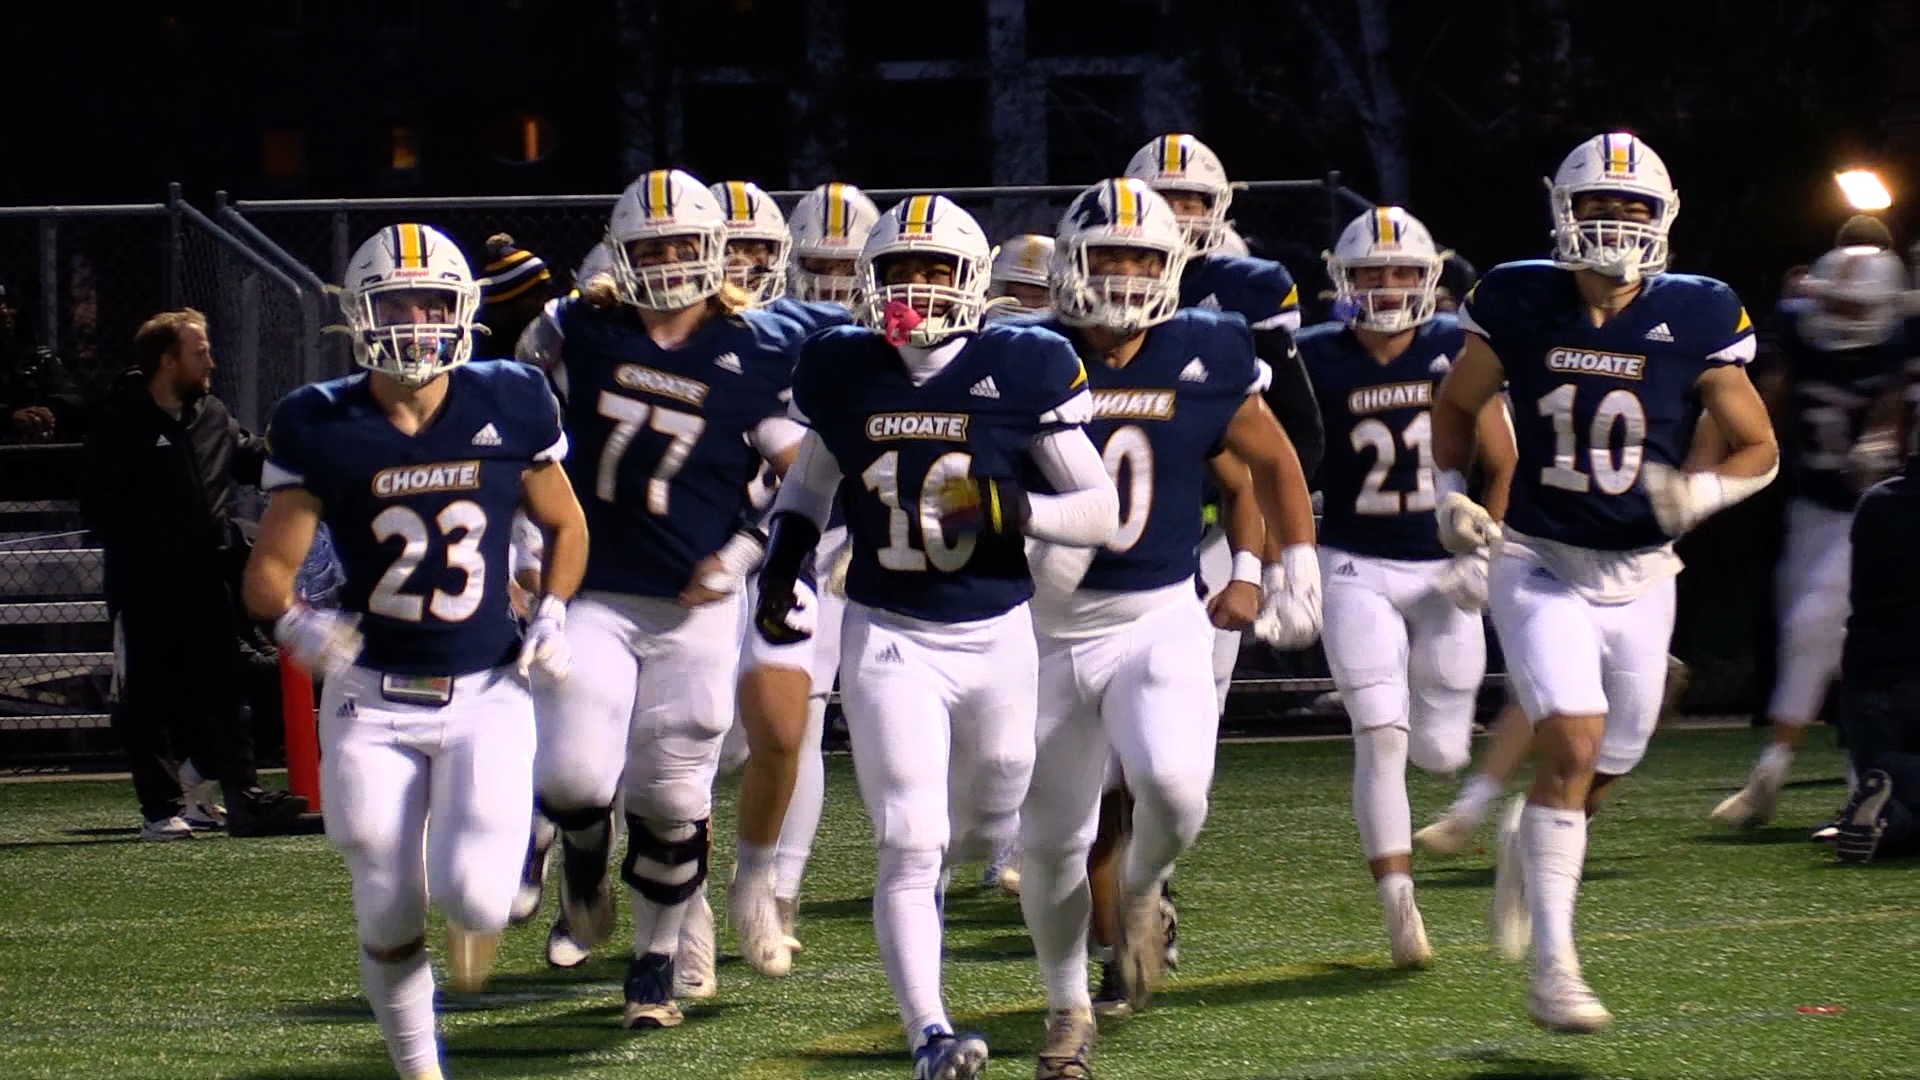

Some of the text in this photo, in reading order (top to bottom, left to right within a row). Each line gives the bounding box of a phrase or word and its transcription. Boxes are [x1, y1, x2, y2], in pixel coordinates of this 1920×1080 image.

[1351, 383, 1428, 411] CHOATE
[1549, 351, 1643, 376] CHOATE
[869, 416, 966, 438] CHOATE
[1093, 391, 1171, 418] HOATE
[596, 389, 707, 516] 77
[1348, 410, 1437, 516] 21
[1537, 383, 1646, 496] 10
[375, 463, 476, 495] CHOATE
[1102, 425, 1154, 553] 0
[367, 499, 489, 624] 23
